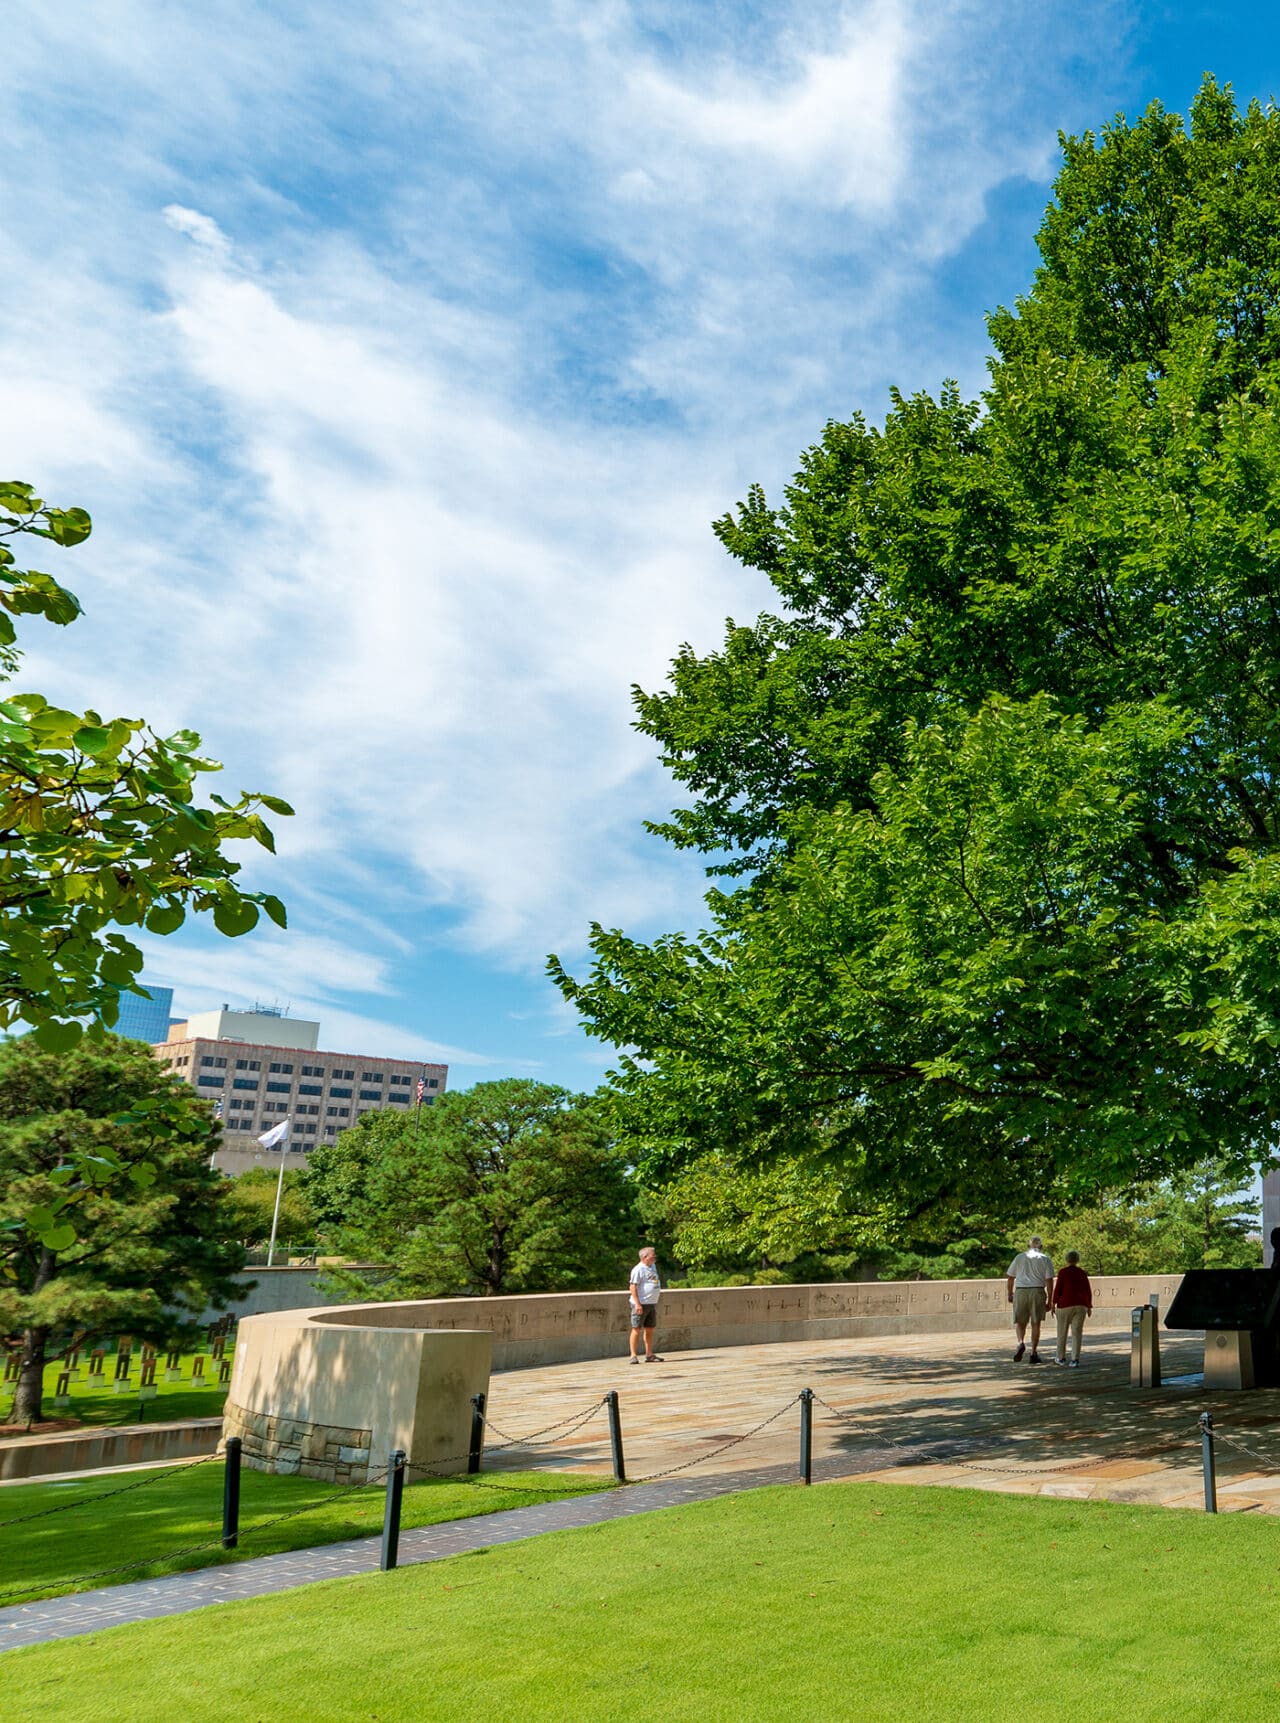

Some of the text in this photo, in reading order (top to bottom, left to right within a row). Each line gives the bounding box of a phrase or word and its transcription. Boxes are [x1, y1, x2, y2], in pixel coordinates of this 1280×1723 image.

[487, 1312, 529, 1327] AND
[664, 1302, 722, 1316] TION
[1093, 1287, 1136, 1297] OUR
